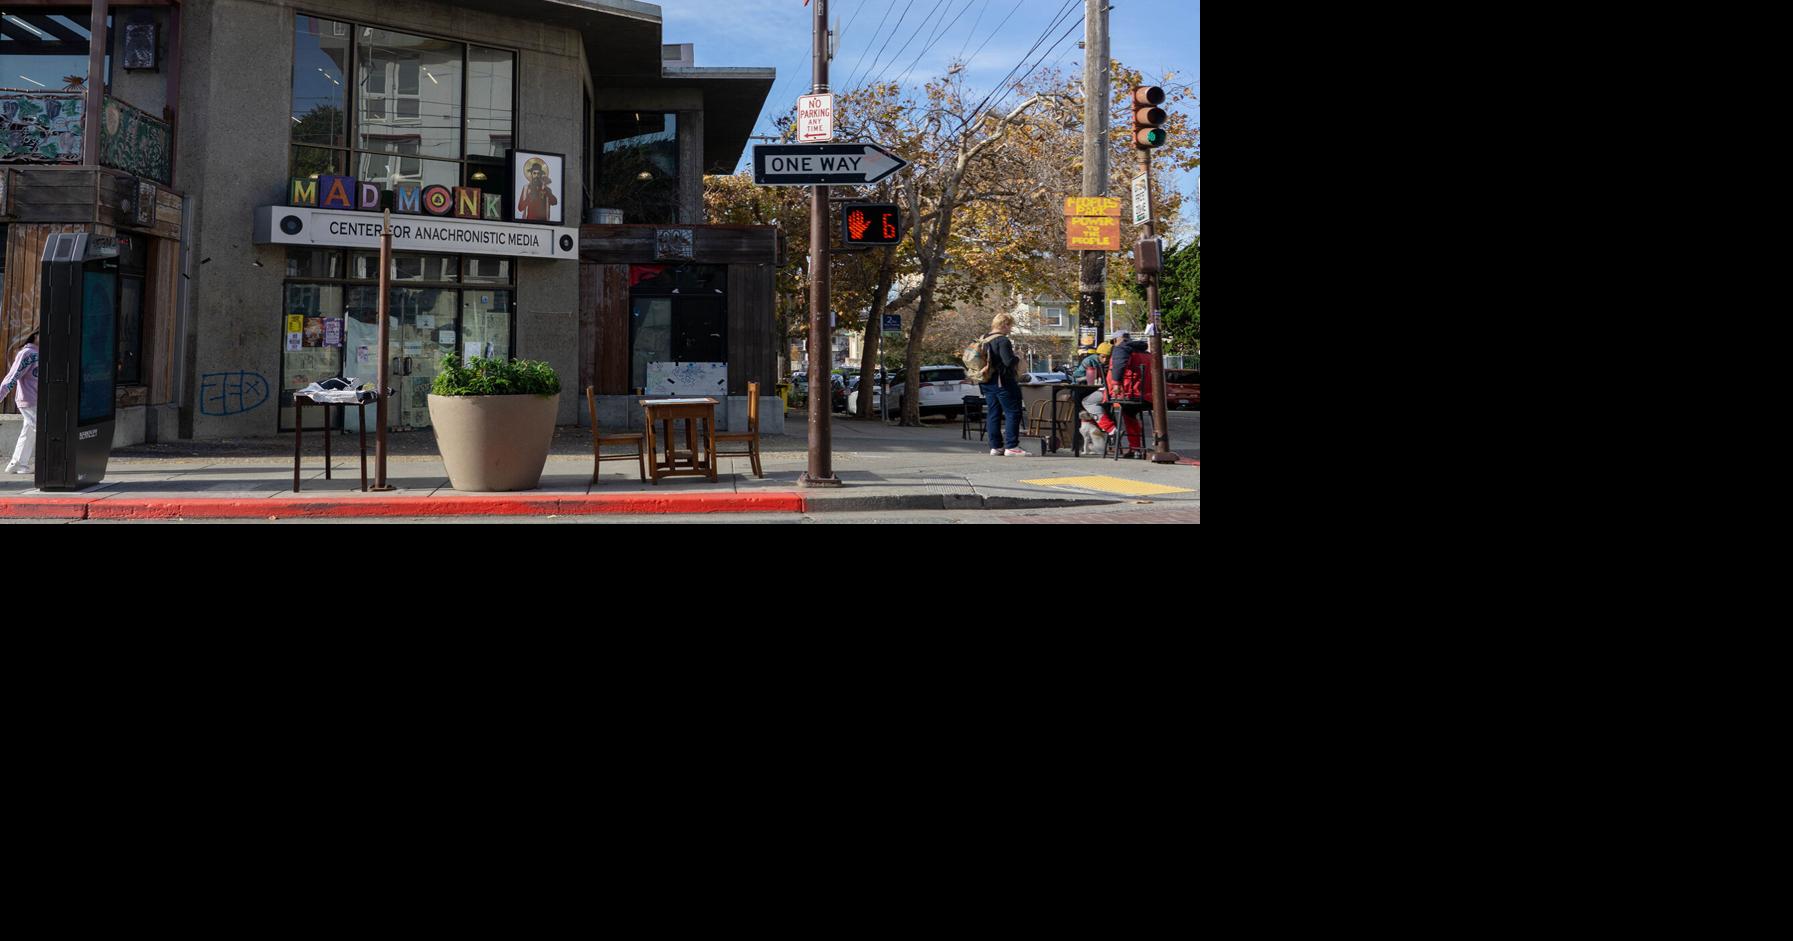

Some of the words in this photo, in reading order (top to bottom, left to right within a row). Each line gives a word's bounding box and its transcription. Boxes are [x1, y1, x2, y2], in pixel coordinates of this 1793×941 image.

[808, 99, 822, 108] NO
[800, 109, 830, 118] PARKING
[771, 157, 813, 172] ONE
[820, 156, 862, 171] WAY
[292, 177, 380, 209] MAD
[397, 184, 501, 219] MONK
[1075, 205, 1106, 216] PARK
[882, 213, 896, 239] 6
[1071, 217, 1115, 226] POWER
[329, 221, 383, 237] CENTER
[414, 226, 506, 245] ANACHRONISTIC
[508, 232, 540, 247] MEDIA
[1071, 236, 1110, 246] PEOPLE
